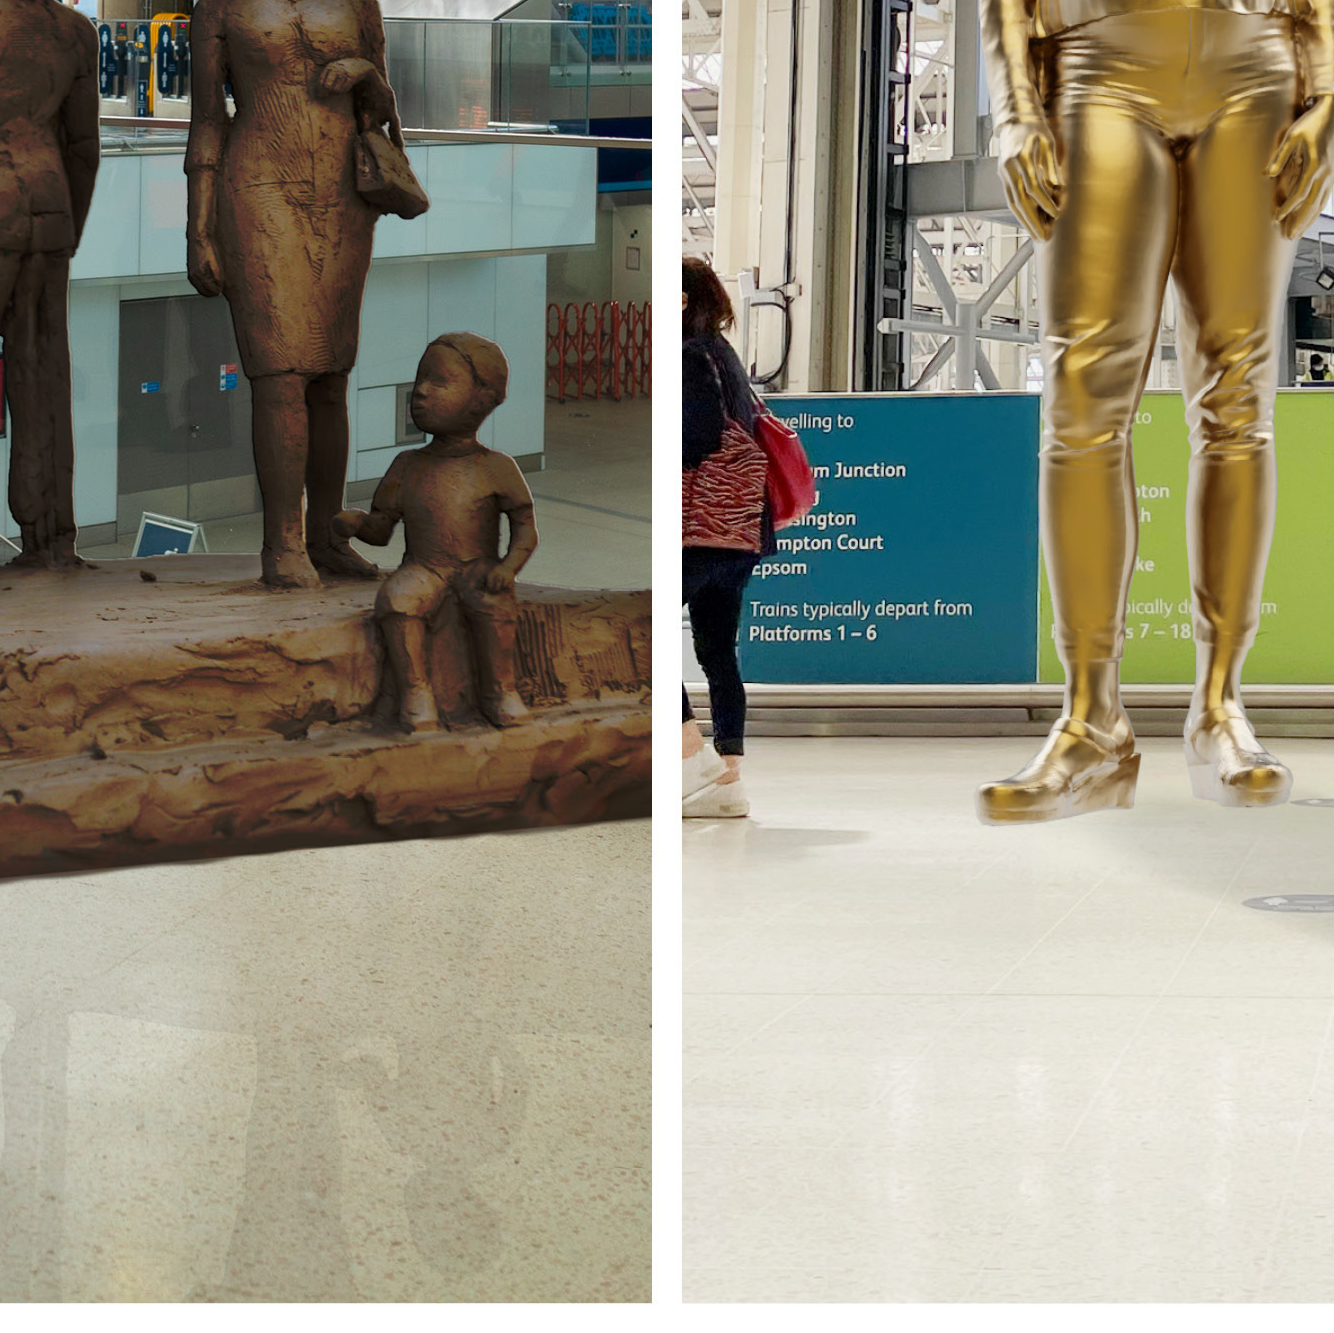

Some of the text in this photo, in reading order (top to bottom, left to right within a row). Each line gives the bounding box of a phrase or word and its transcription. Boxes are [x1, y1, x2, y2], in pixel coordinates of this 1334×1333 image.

[775, 413, 855, 433] velling to
[1134, 414, 1152, 425] to
[834, 462, 906, 478] Junction
[792, 512, 856, 530] sington
[776, 534, 884, 554] mpton Court
[750, 599, 973, 621] Trains typically depart from
[749, 625, 832, 642] Platforms
[837, 625, 846, 641] 1
[866, 624, 877, 641] 6
[1139, 623, 1150, 639] 7
[1170, 623, 1192, 639] 18
